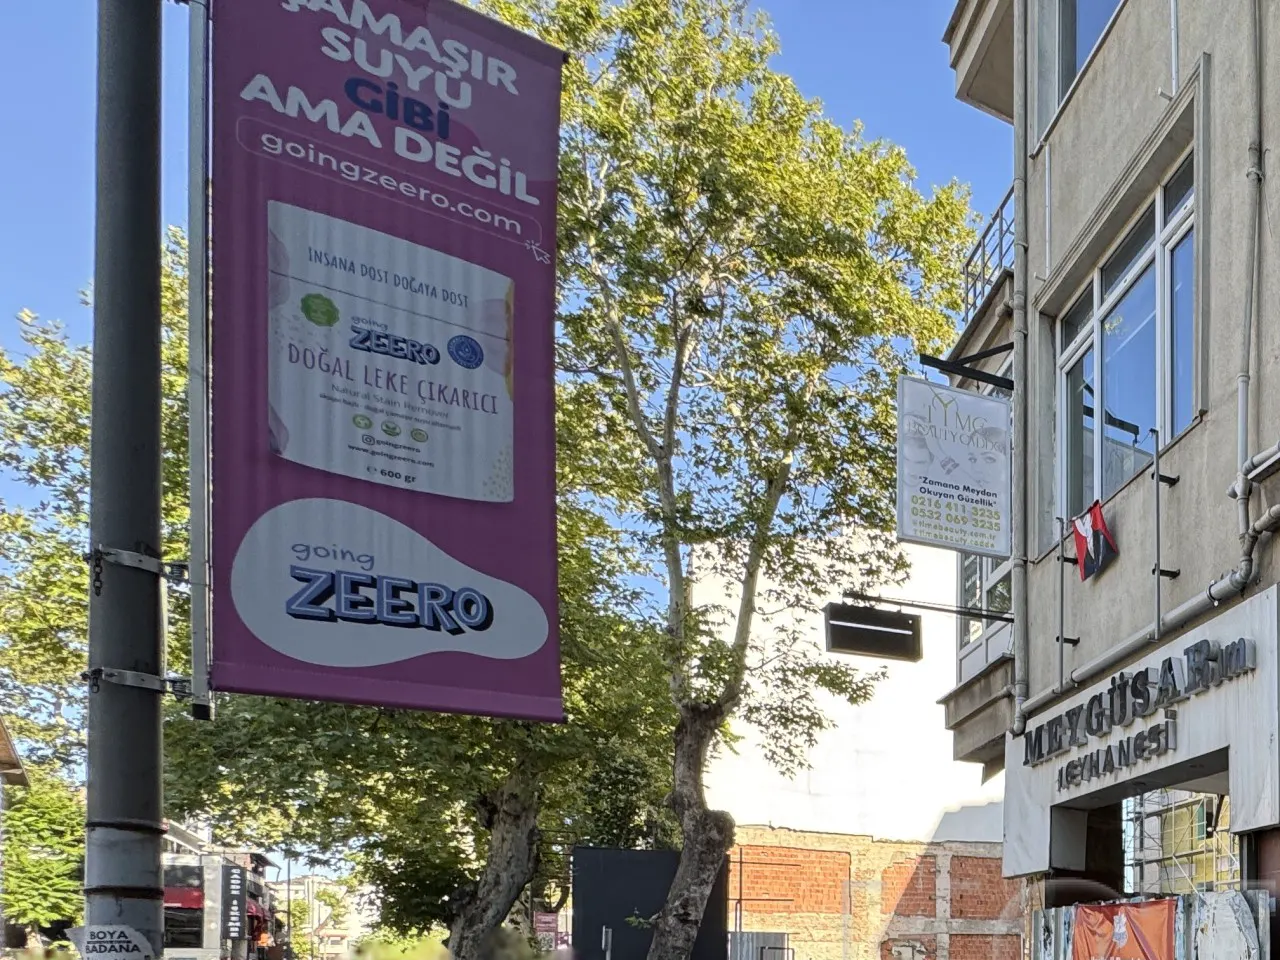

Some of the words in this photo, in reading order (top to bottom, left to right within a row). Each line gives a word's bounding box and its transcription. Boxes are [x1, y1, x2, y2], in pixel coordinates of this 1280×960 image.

[282, 0, 519, 95] AMAŞIR
[321, 27, 472, 109] SUYU
[344, 77, 450, 139] GİBİ
[240, 74, 382, 148] AMA
[394, 126, 540, 206] DEĞİL
[260, 131, 521, 235] goingzeero.com
[360, 263, 388, 283] DOST
[394, 271, 437, 300] DOĞAYA
[442, 288, 468, 308] DOST
[349, 325, 441, 366] ZEERO
[288, 342, 355, 382] DOĞAL
[363, 365, 409, 396] LEKE
[417, 379, 499, 415] ÇIKARICI
[380, 468, 401, 479] 600
[404, 474, 416, 484] gr
[919, 486, 955, 500] Okuyan
[963, 484, 998, 499] Meydan
[911, 495, 942, 509] 0216
[945, 501, 967, 514] 411
[971, 506, 1001, 520] 3235
[911, 506, 942, 521] 0532
[945, 513, 969, 525] 069
[972, 518, 1001, 532] 3235
[290, 542, 375, 572] going
[285, 564, 495, 636] ZEERO
[85, 944, 141, 954] BADANA
[89, 931, 128, 940] BOYA
